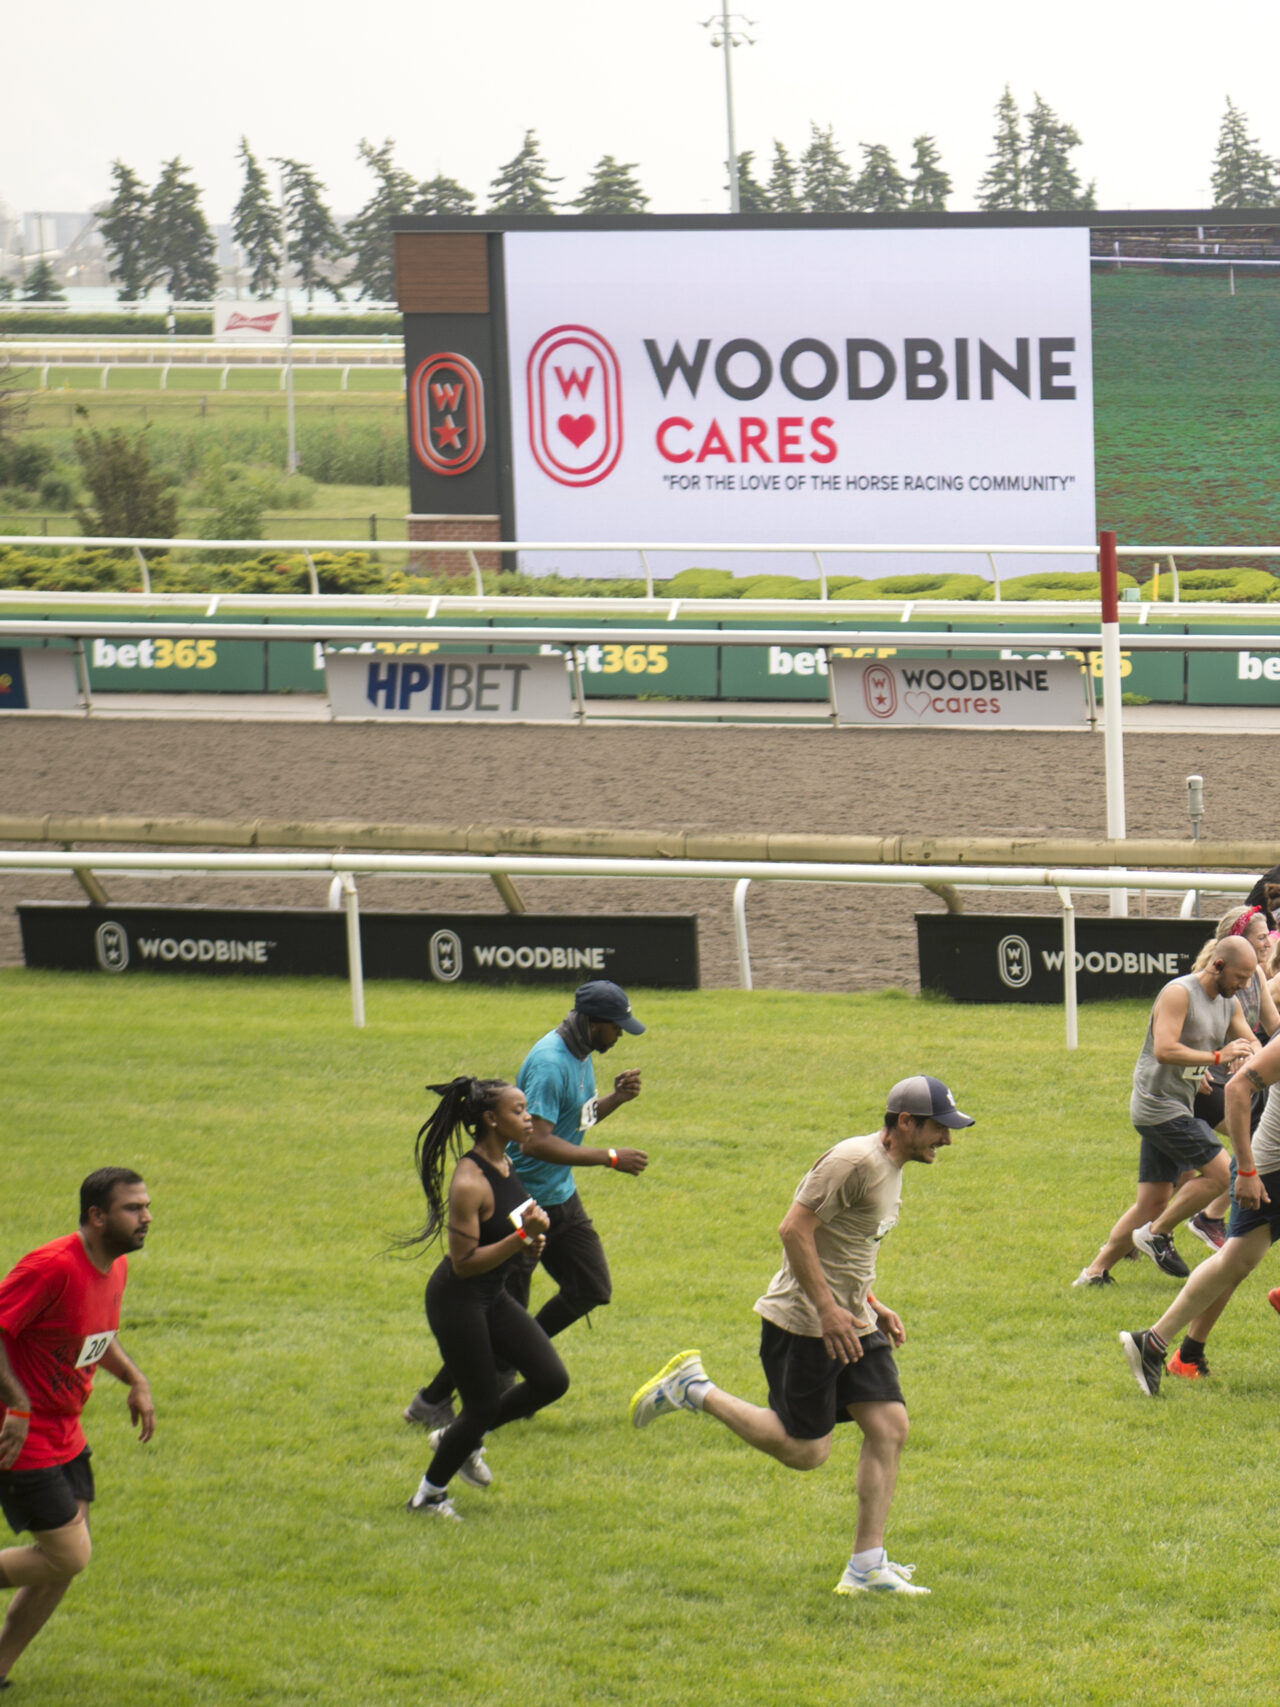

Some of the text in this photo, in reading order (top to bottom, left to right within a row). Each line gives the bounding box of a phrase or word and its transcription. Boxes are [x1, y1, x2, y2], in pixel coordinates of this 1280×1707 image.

[553, 366, 595, 401] W
[643, 337, 1076, 401] WOODBINE
[430, 383, 464, 412] W
[655, 416, 838, 464] CARES
[705, 474, 735, 491] THE
[740, 474, 780, 491] LOVE
[785, 474, 806, 491] OF
[811, 474, 841, 491] THE
[846, 475, 899, 491] HORSE
[904, 475, 964, 491] RACING
[93, 638, 217, 669] bet365
[367, 662, 531, 712] HPIBET
[902, 669, 1049, 691] WOODBINE
[932, 697, 1001, 713] cares
[84, 1337, 107, 1361] 20
